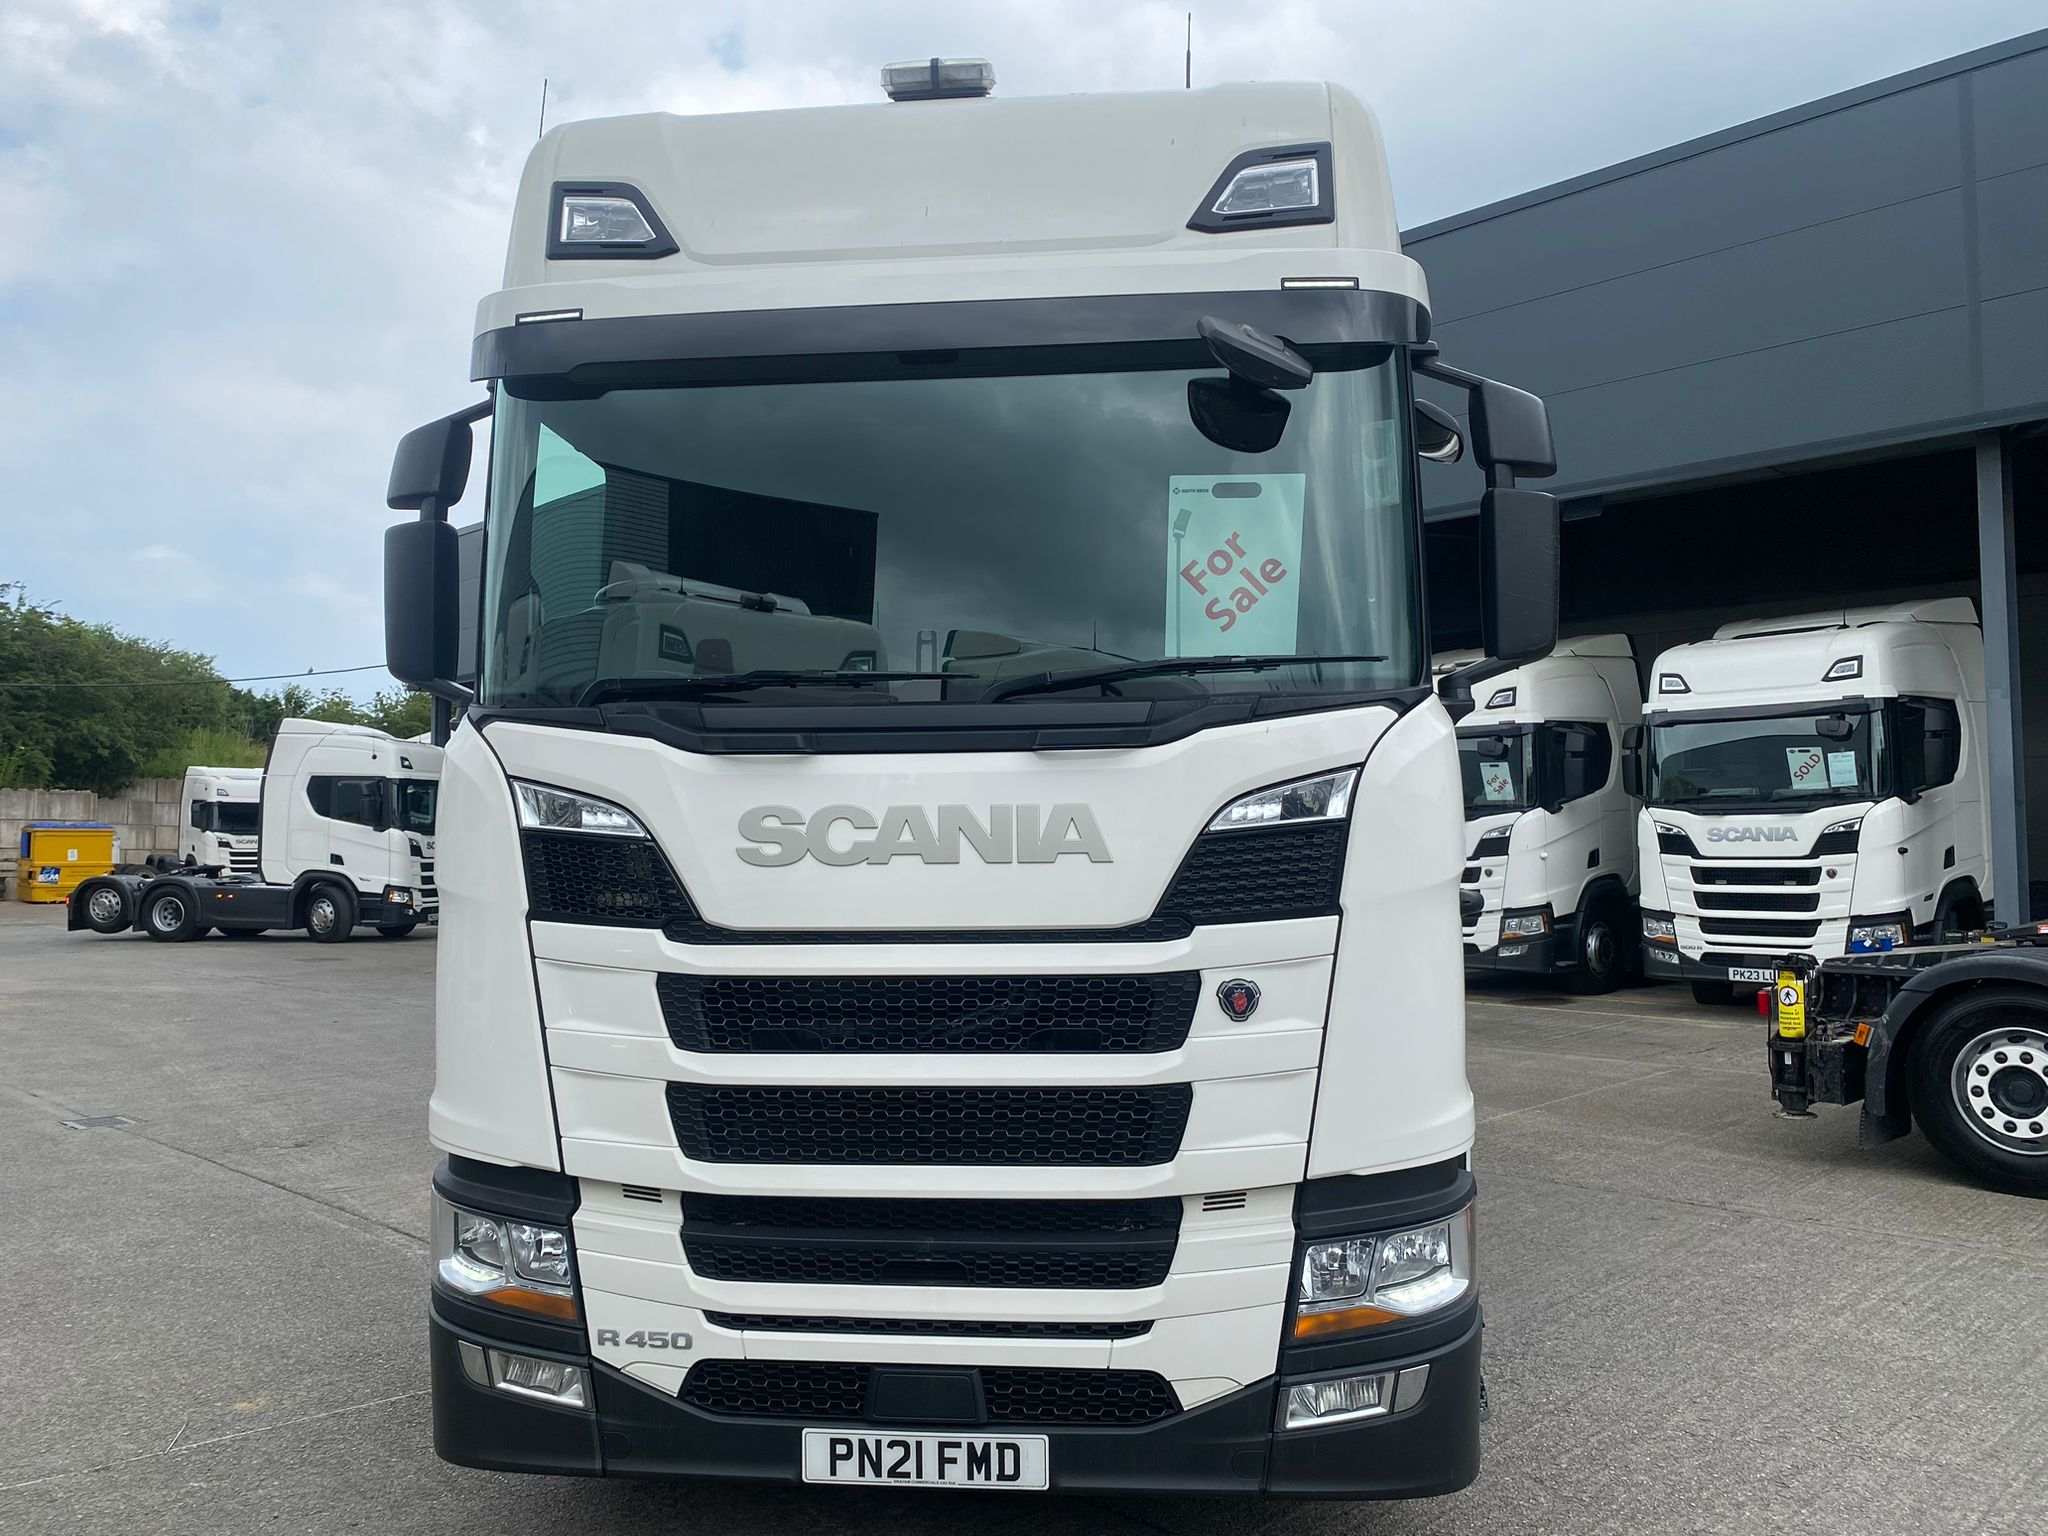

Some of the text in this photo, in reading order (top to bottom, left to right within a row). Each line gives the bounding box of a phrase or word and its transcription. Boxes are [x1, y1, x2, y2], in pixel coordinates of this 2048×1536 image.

[1180, 531, 1247, 596] For
[1205, 558, 1288, 633] Sale
[1794, 753, 1821, 781] SOLD
[1486, 774, 1500, 787] For
[1493, 779, 1509, 795] Sale
[735, 803, 1114, 867] SCANIA
[1706, 826, 1799, 842] SCANIA
[1733, 969, 1760, 980] PK23
[597, 1328, 693, 1350] R 450
[829, 1437, 1021, 1482] PN21 FMD
